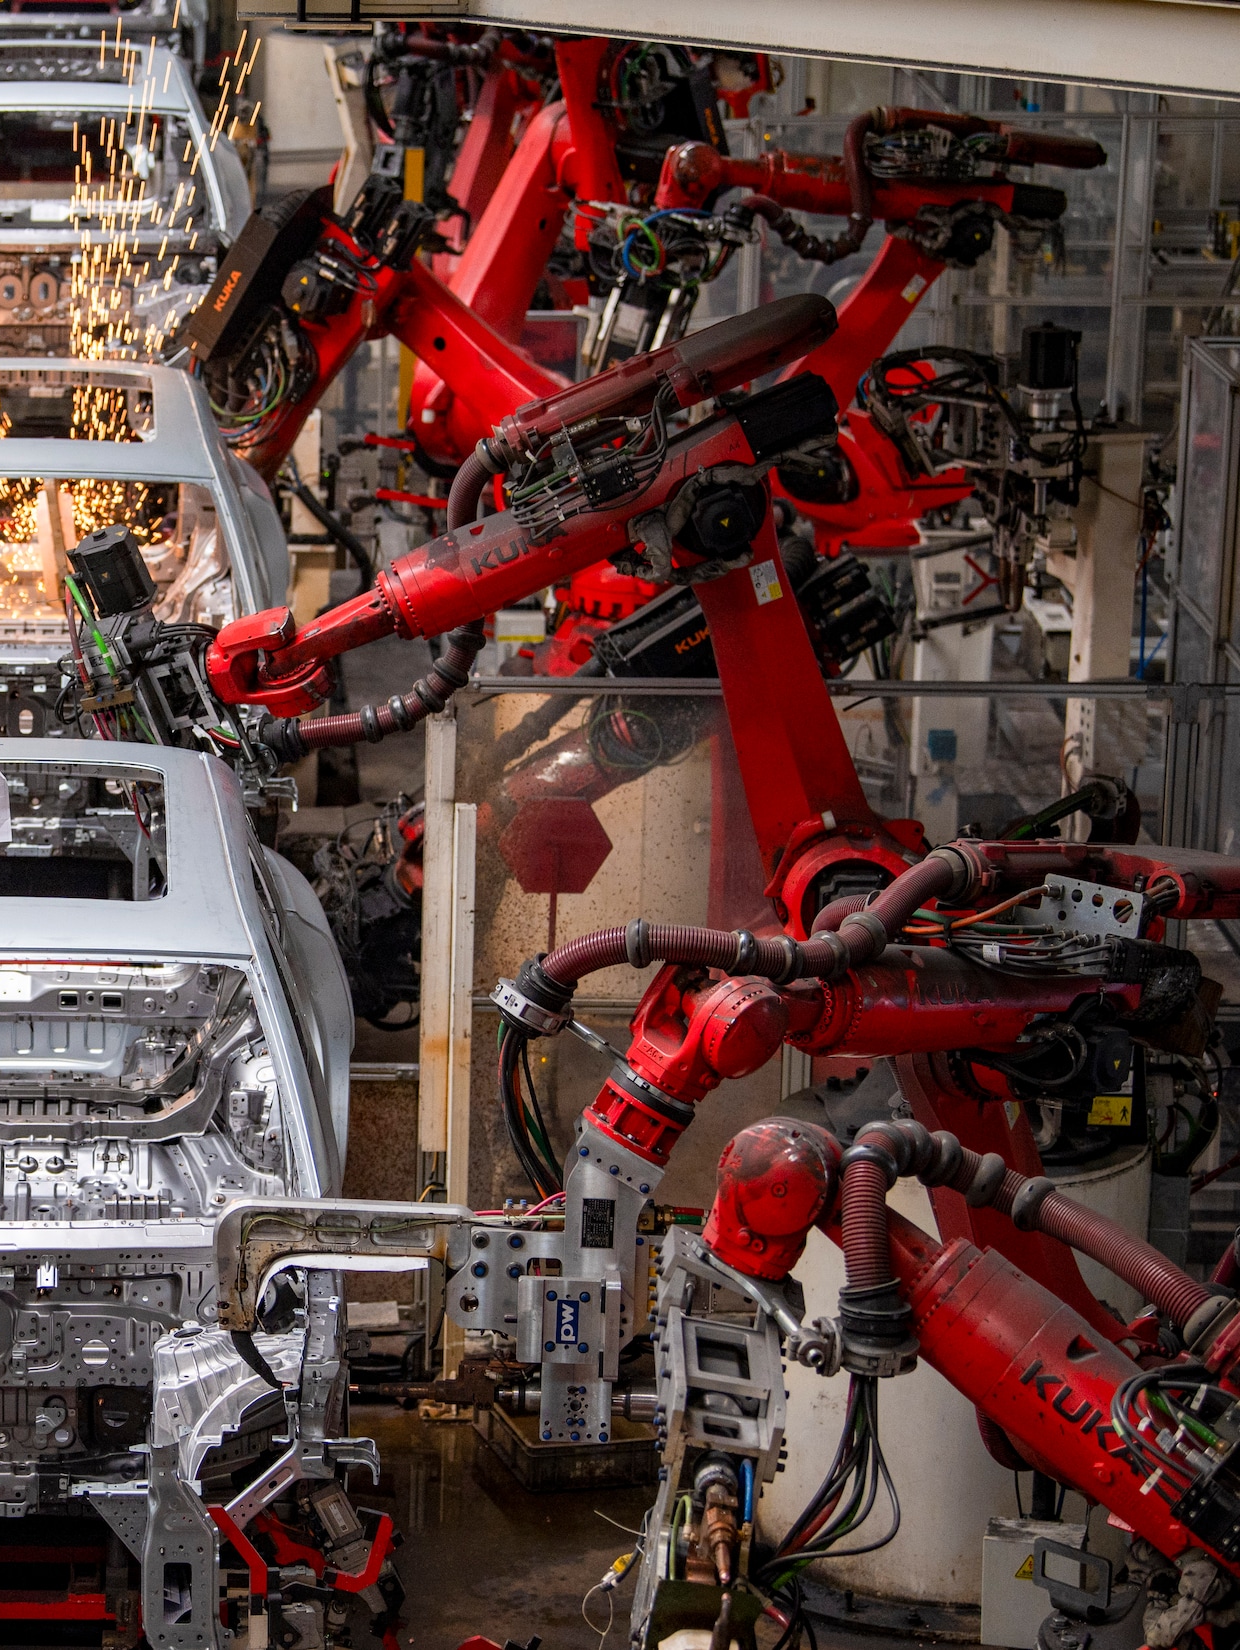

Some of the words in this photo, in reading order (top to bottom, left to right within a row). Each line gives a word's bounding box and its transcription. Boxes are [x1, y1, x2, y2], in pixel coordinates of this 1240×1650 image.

[213, 269, 242, 312] KUKA
[674, 626, 710, 655] KUK
[560, 1303, 576, 1342] pw
[1019, 1359, 1143, 1477] KUKA
